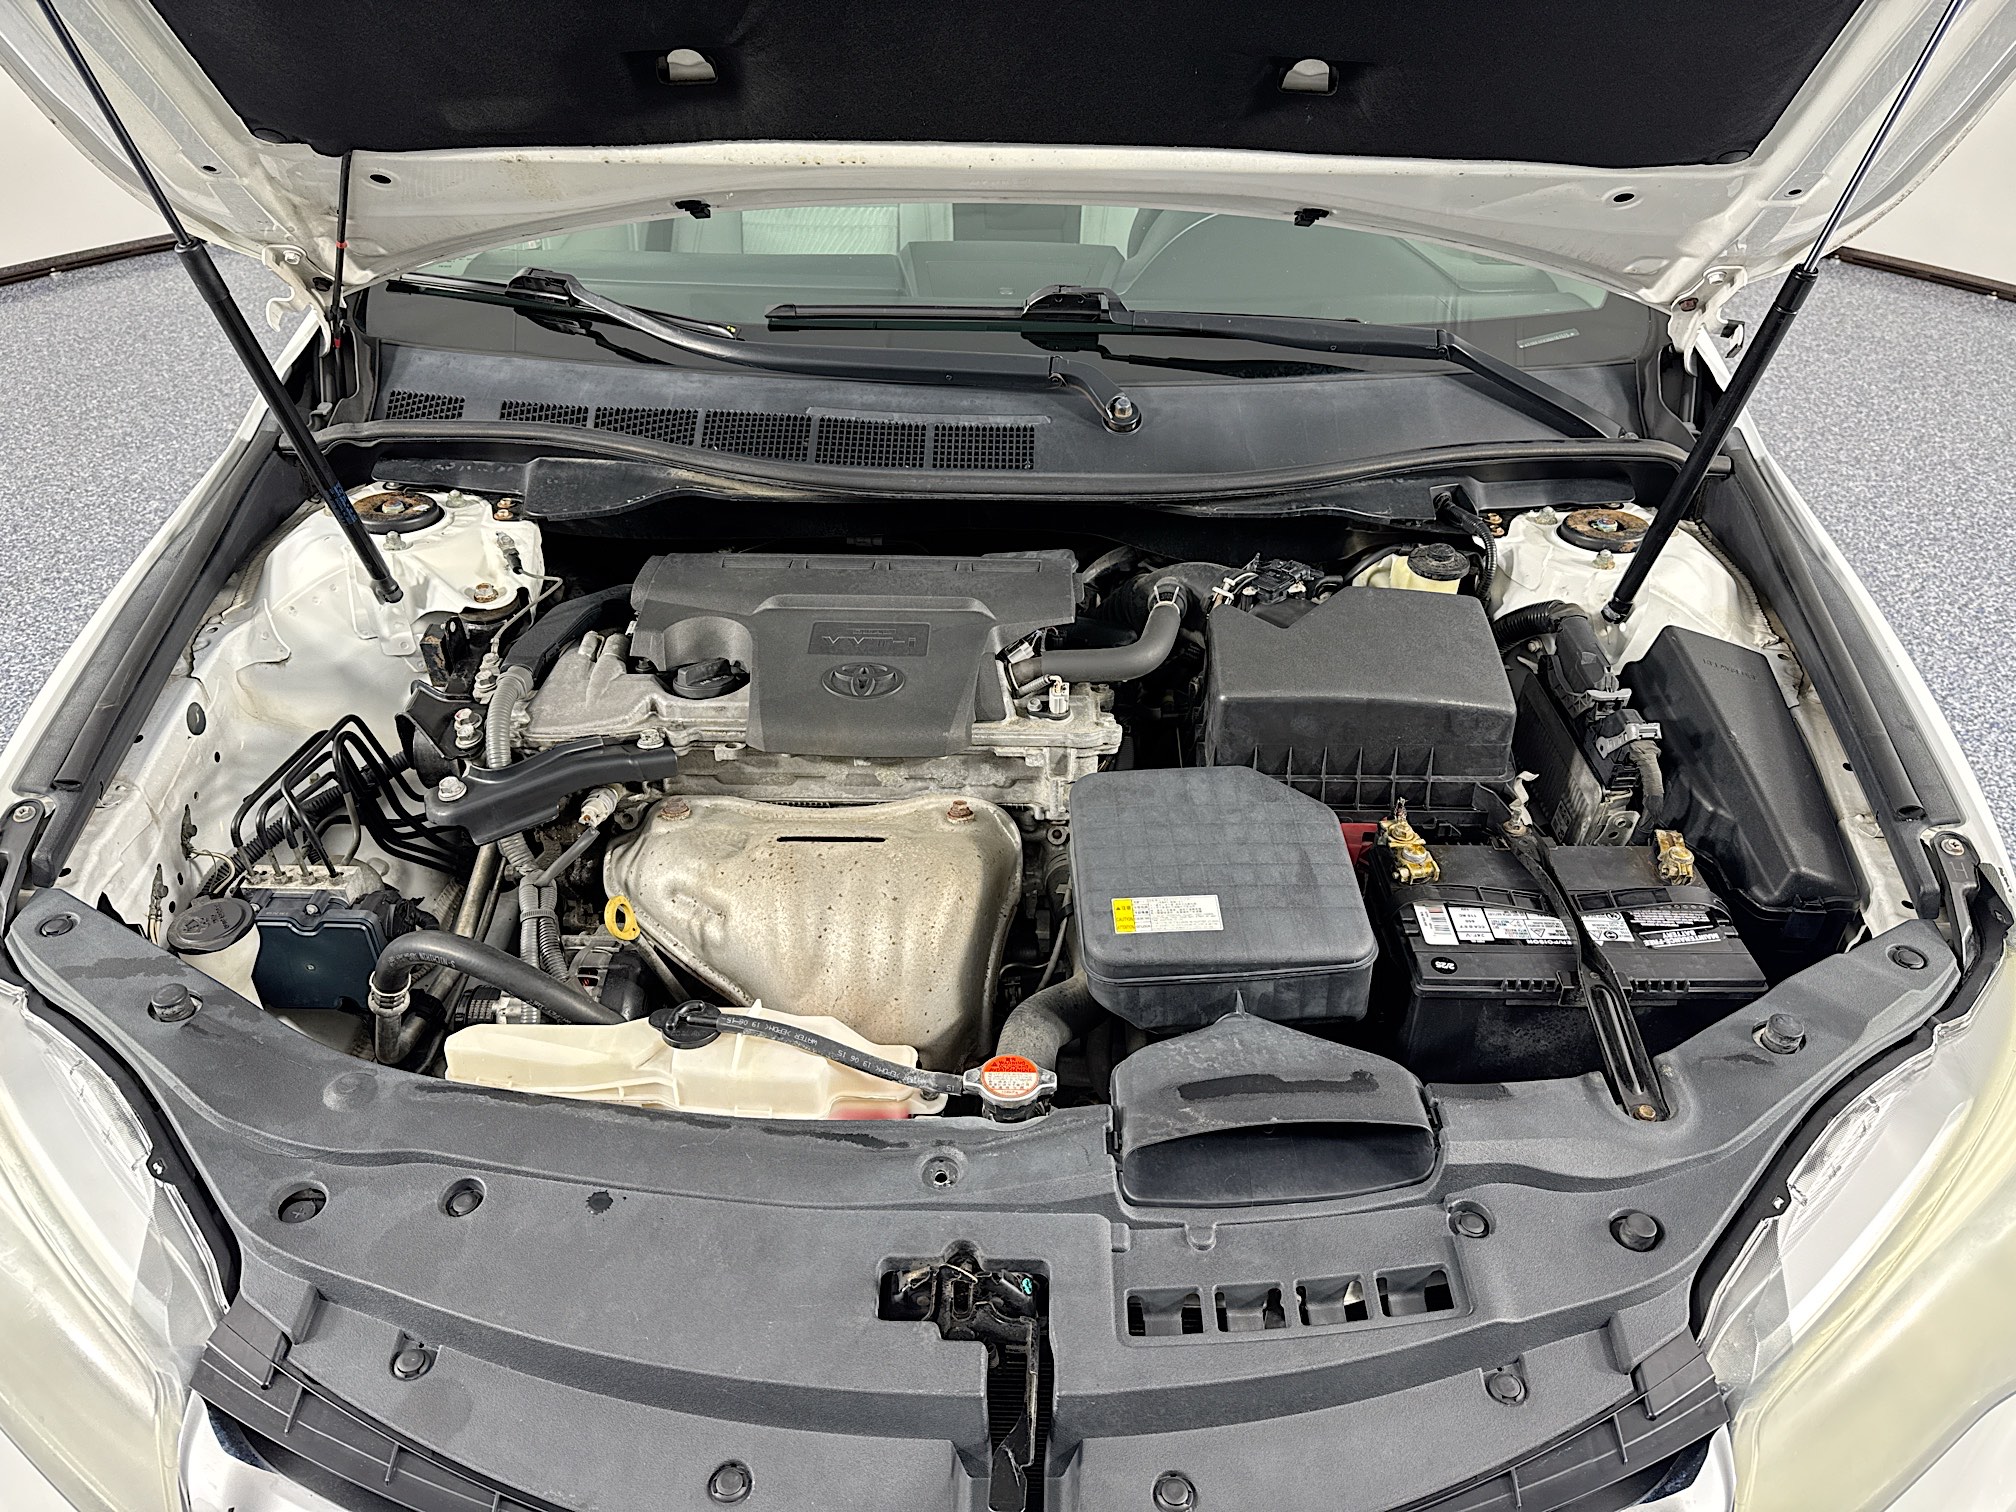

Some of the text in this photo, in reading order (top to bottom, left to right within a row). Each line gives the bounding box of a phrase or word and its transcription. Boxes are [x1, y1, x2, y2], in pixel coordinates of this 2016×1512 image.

[1662, 929, 1697, 939] BATTERY
[1643, 932, 1719, 947] MAINTENANCE-FREE
[1434, 960, 1456, 971] 2/25
[794, 1033, 818, 1046] WATER
[836, 1049, 847, 1058] 15
[850, 1055, 860, 1064] 06
